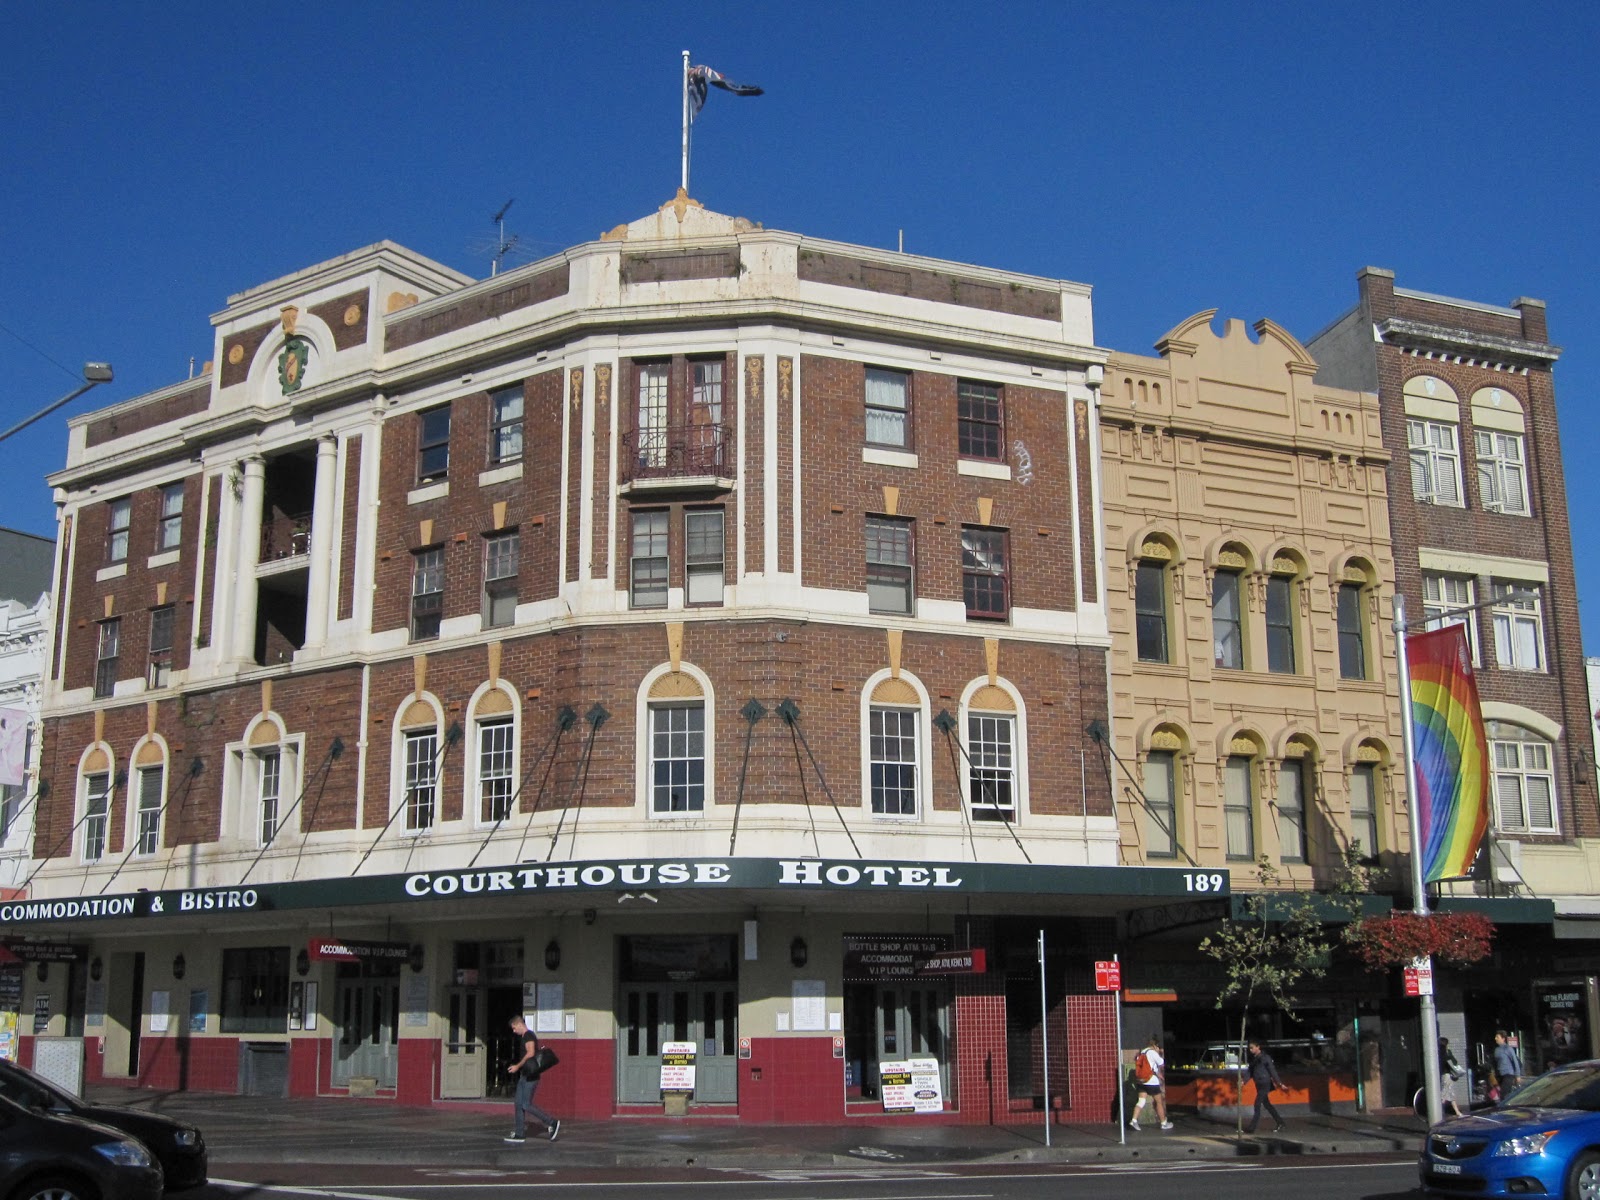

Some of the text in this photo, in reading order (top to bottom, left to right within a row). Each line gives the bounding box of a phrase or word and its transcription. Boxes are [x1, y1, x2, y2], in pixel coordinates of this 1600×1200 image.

[405, 861, 962, 896] COURTHOUSE HOTEL
[1183, 874, 1223, 892] 189
[0, 889, 258, 921] COMMODATION & BISTRO
[320, 944, 370, 955] ACCOMMODATION
[385, 948, 408, 958] LOUNGE
[849, 943, 879, 951] BOTTLE
[880, 943, 902, 952] SHOP,
[861, 954, 913, 963] ACCOMMODAT
[964, 957, 972, 966] TAB
[1558, 992, 1579, 1001] FLAVOUR
[36, 1000, 49, 1009] ATM
